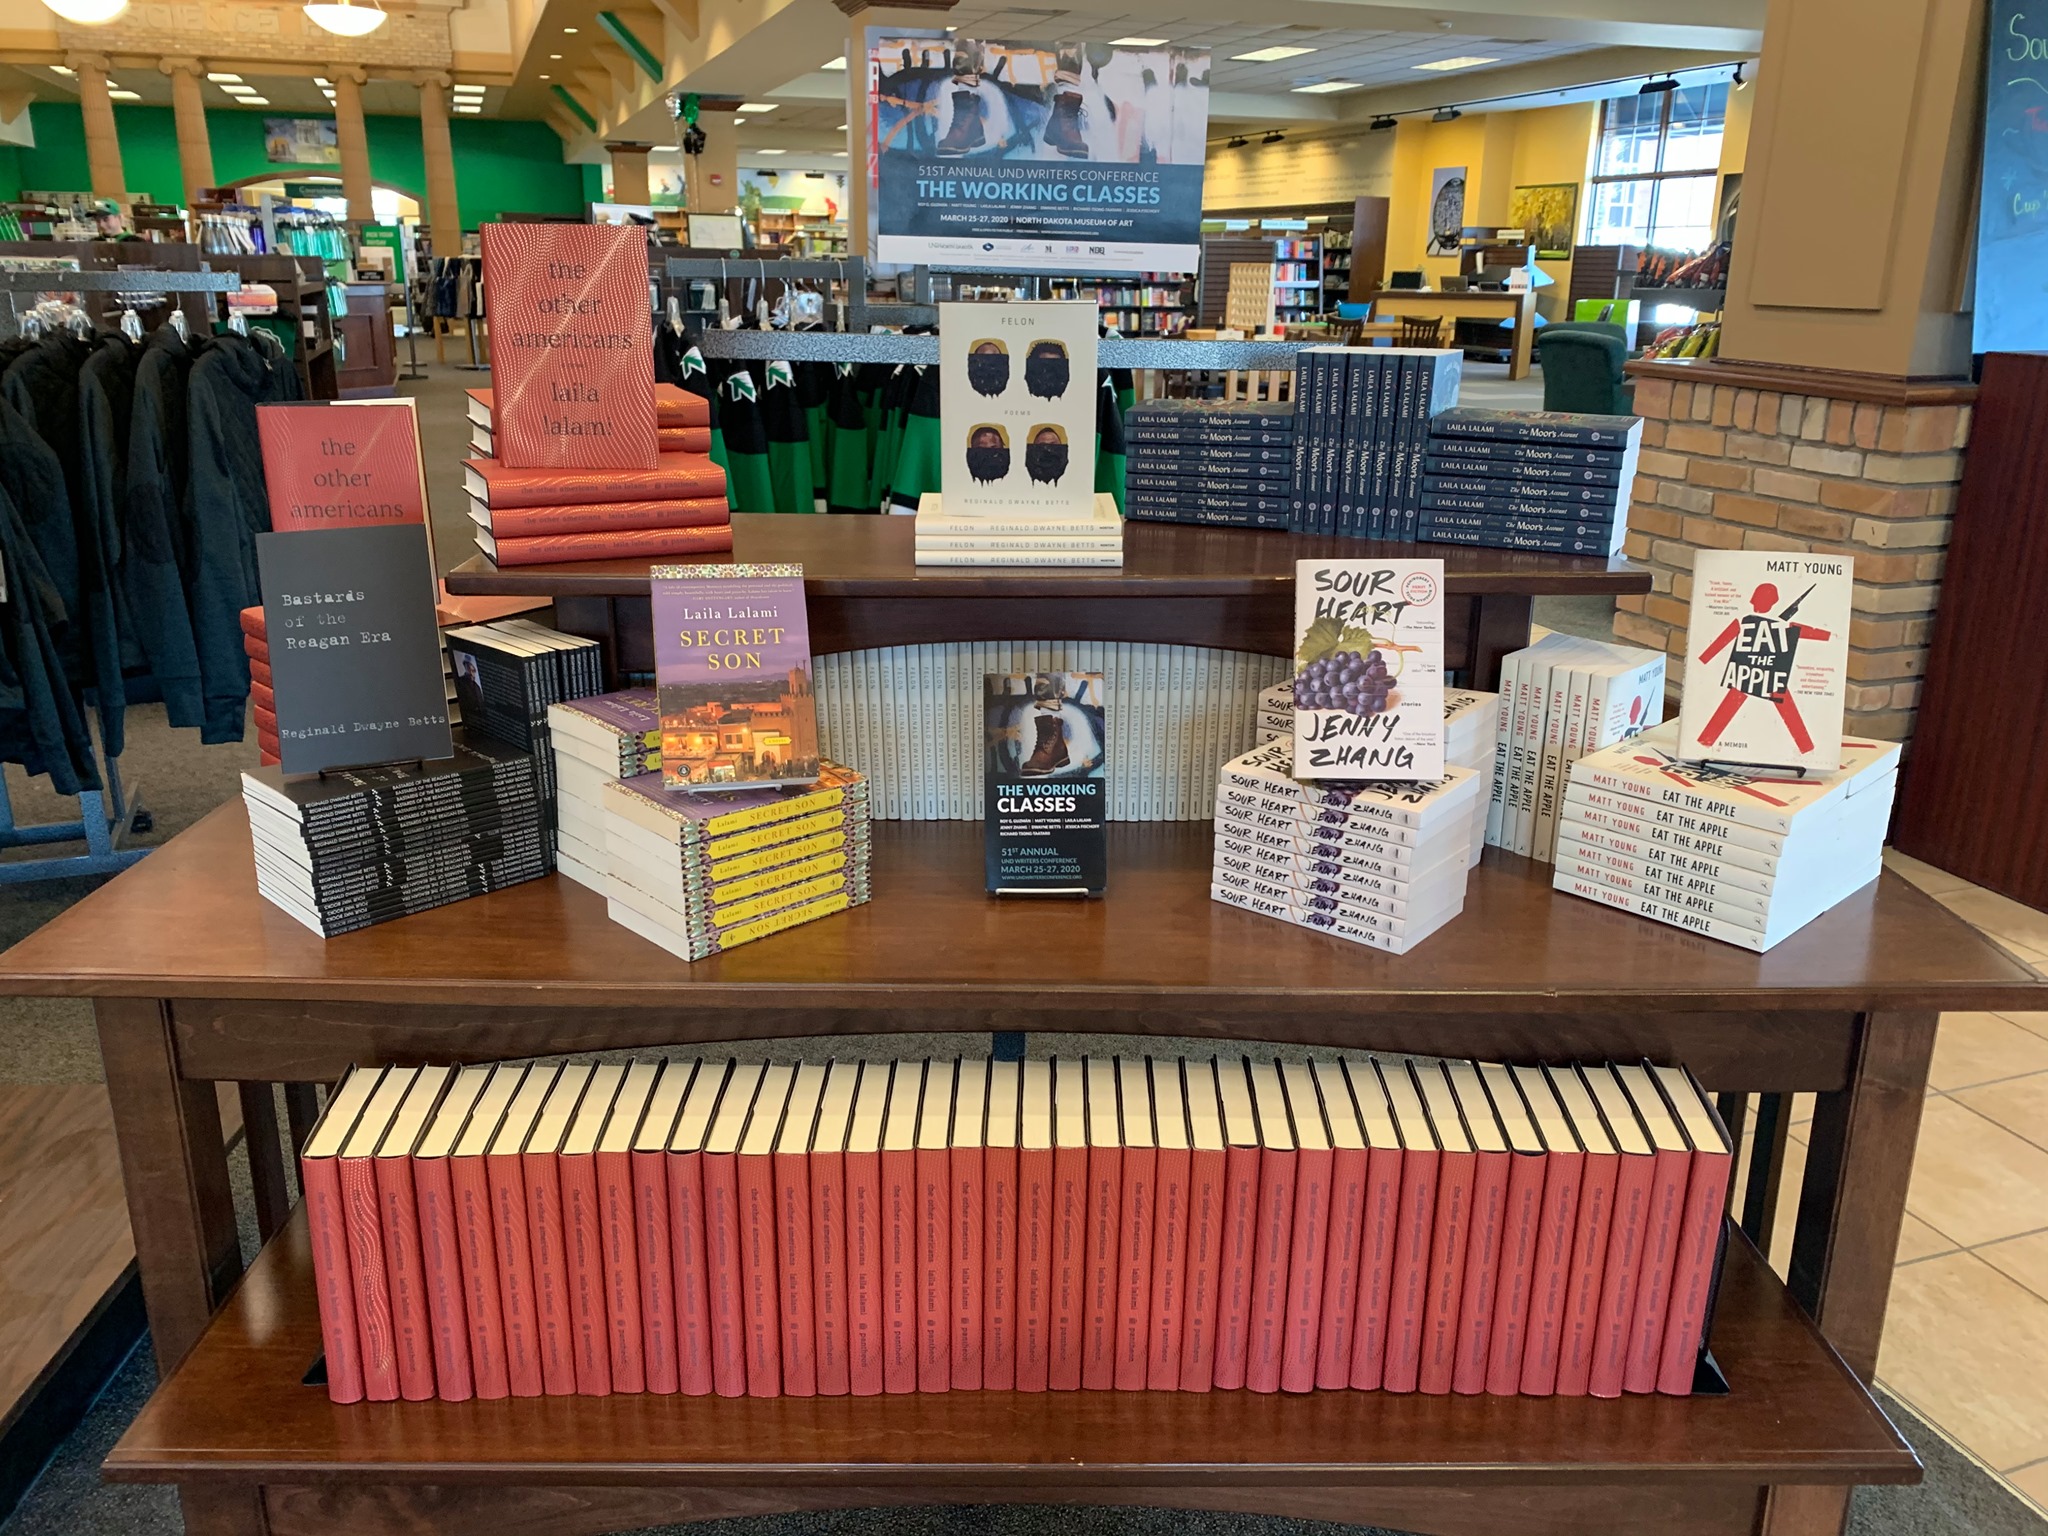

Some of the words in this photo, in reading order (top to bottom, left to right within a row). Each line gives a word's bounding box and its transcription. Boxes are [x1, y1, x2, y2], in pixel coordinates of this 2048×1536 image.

[919, 166, 945, 176] 51ST
[948, 167, 994, 177] ANNUAL
[998, 168, 1024, 178] UND
[1027, 169, 1077, 180] WRITERS
[1080, 170, 1159, 182] CONFERENCE
[916, 180, 956, 198] THE
[962, 182, 1067, 201] WORKING
[1073, 185, 1160, 204] CLASSES
[969, 215, 990, 223] 25-27,
[550, 260, 585, 279] the
[539, 293, 600, 314] other
[1001, 317, 1035, 326] FELON
[512, 330, 632, 349] americans
[552, 383, 599, 402] laila
[544, 416, 612, 436] lalami
[1156, 416, 1178, 424] LALAMI
[1209, 417, 1232, 426] Moor's
[1468, 425, 1494, 433] LALAMI
[1530, 428, 1556, 438] Moor's
[321, 438, 356, 456] the
[314, 469, 371, 487] other
[291, 500, 403, 518] americans
[1454, 532, 1479, 540] LALAMI
[1514, 536, 1540, 546] Moor's
[1766, 560, 1799, 573] MATT
[1804, 562, 1842, 575] YOUNG
[1314, 568, 1396, 597] SOUR
[282, 590, 365, 607] Bastards
[285, 615, 304, 628] of
[317, 613, 346, 626] the
[684, 607, 722, 620] Laila
[728, 606, 778, 619] Lalami
[1315, 597, 1412, 625] HEART
[286, 633, 350, 650] Reagan
[360, 631, 392, 644] Era
[680, 628, 785, 647] SECRET
[1736, 620, 1790, 653] EAT
[708, 652, 761, 670] SON
[1748, 655, 1776, 666] THE
[1723, 661, 1787, 698] APPLE
[1503, 679, 1512, 703] MATT
[282, 724, 346, 739] Reginald
[353, 720, 400, 732] Dwayne
[408, 714, 446, 727] Betts
[1303, 712, 1400, 743] JENNY
[1499, 707, 1509, 733] YOUNG
[1309, 745, 1414, 769] ZHANG
[1498, 742, 1507, 759] EAT
[1494, 760, 1505, 777] THE
[392, 780, 414, 790] BASTARDS
[431, 774, 450, 782] REAGAN
[997, 785, 1023, 796] THE
[1027, 784, 1096, 795] WORKING
[1492, 778, 1503, 803] APPLE
[997, 797, 1076, 813] CLASSES
[1231, 774, 1259, 789] SOUR
[1264, 782, 1300, 798] HEART
[1316, 794, 1351, 810] JENNY
[1353, 804, 1393, 820] ZHANG
[1594, 774, 1617, 787] MATT
[1622, 781, 1651, 796] YOUNG
[1663, 789, 1681, 802] EAT
[1685, 795, 1703, 809] THE
[1706, 801, 1736, 817] APPLE
[1002, 848, 1018, 856] 51ST
[1001, 865, 1032, 873] MARCH
[1034, 865, 1059, 873] 25-27,
[722, 909, 742, 919] Lalami
[754, 893, 793, 911] SECRET
[798, 885, 818, 897] SON
[1575, 883, 1597, 896] MATT
[1602, 891, 1630, 906] YOUNG
[1640, 901, 1658, 915] EAT
[1662, 908, 1679, 922] THE
[1682, 915, 1711, 932] APPLE
[1220, 889, 1247, 905] SOUR
[1252, 898, 1286, 915] HEART
[1300, 911, 1332, 929] JENNY
[1337, 924, 1375, 942] ZHANG
